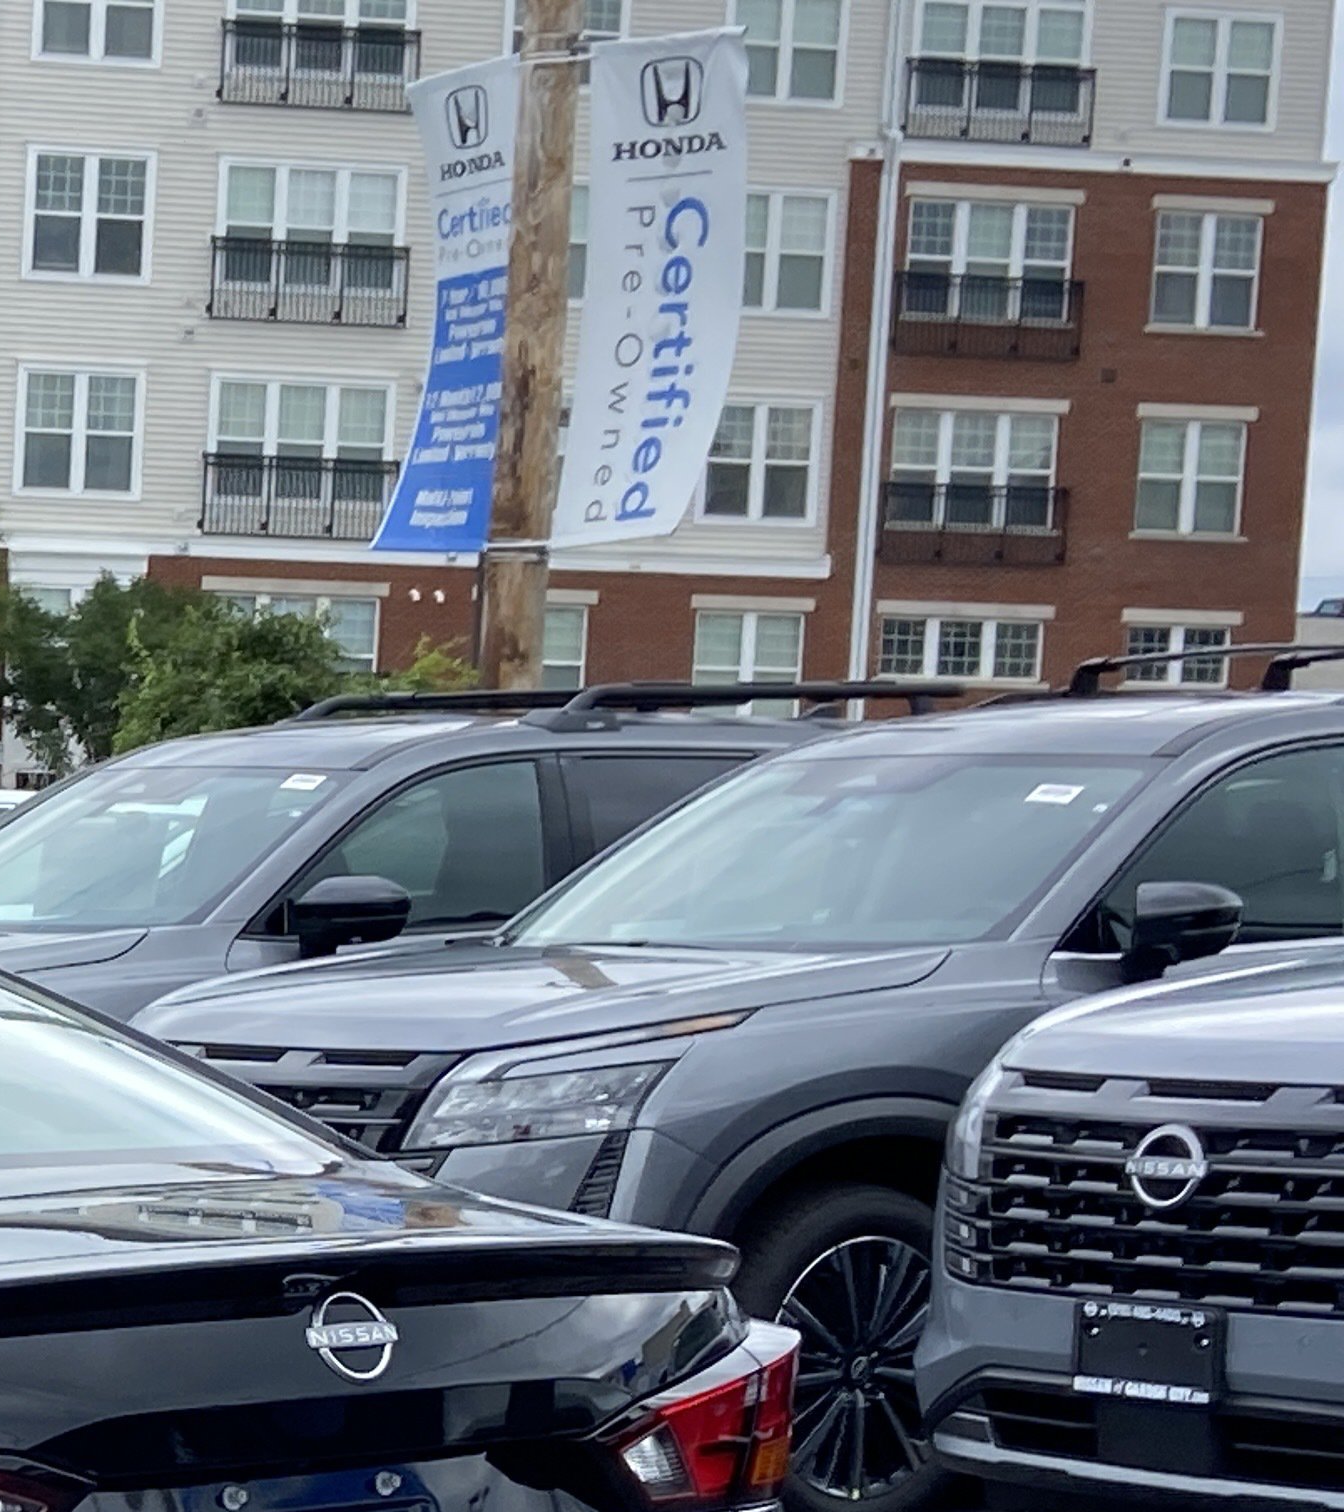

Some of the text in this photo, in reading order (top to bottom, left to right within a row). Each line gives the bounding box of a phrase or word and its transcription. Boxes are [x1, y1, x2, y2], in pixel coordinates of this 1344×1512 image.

[612, 132, 727, 162] HONDA
[440, 151, 505, 181] HONDA
[584, 205, 656, 523] Pre-Owned
[615, 197, 709, 521] Certified
[1125, 1159, 1208, 1178] NISSAN
[310, 1323, 399, 1348] NISSAN
